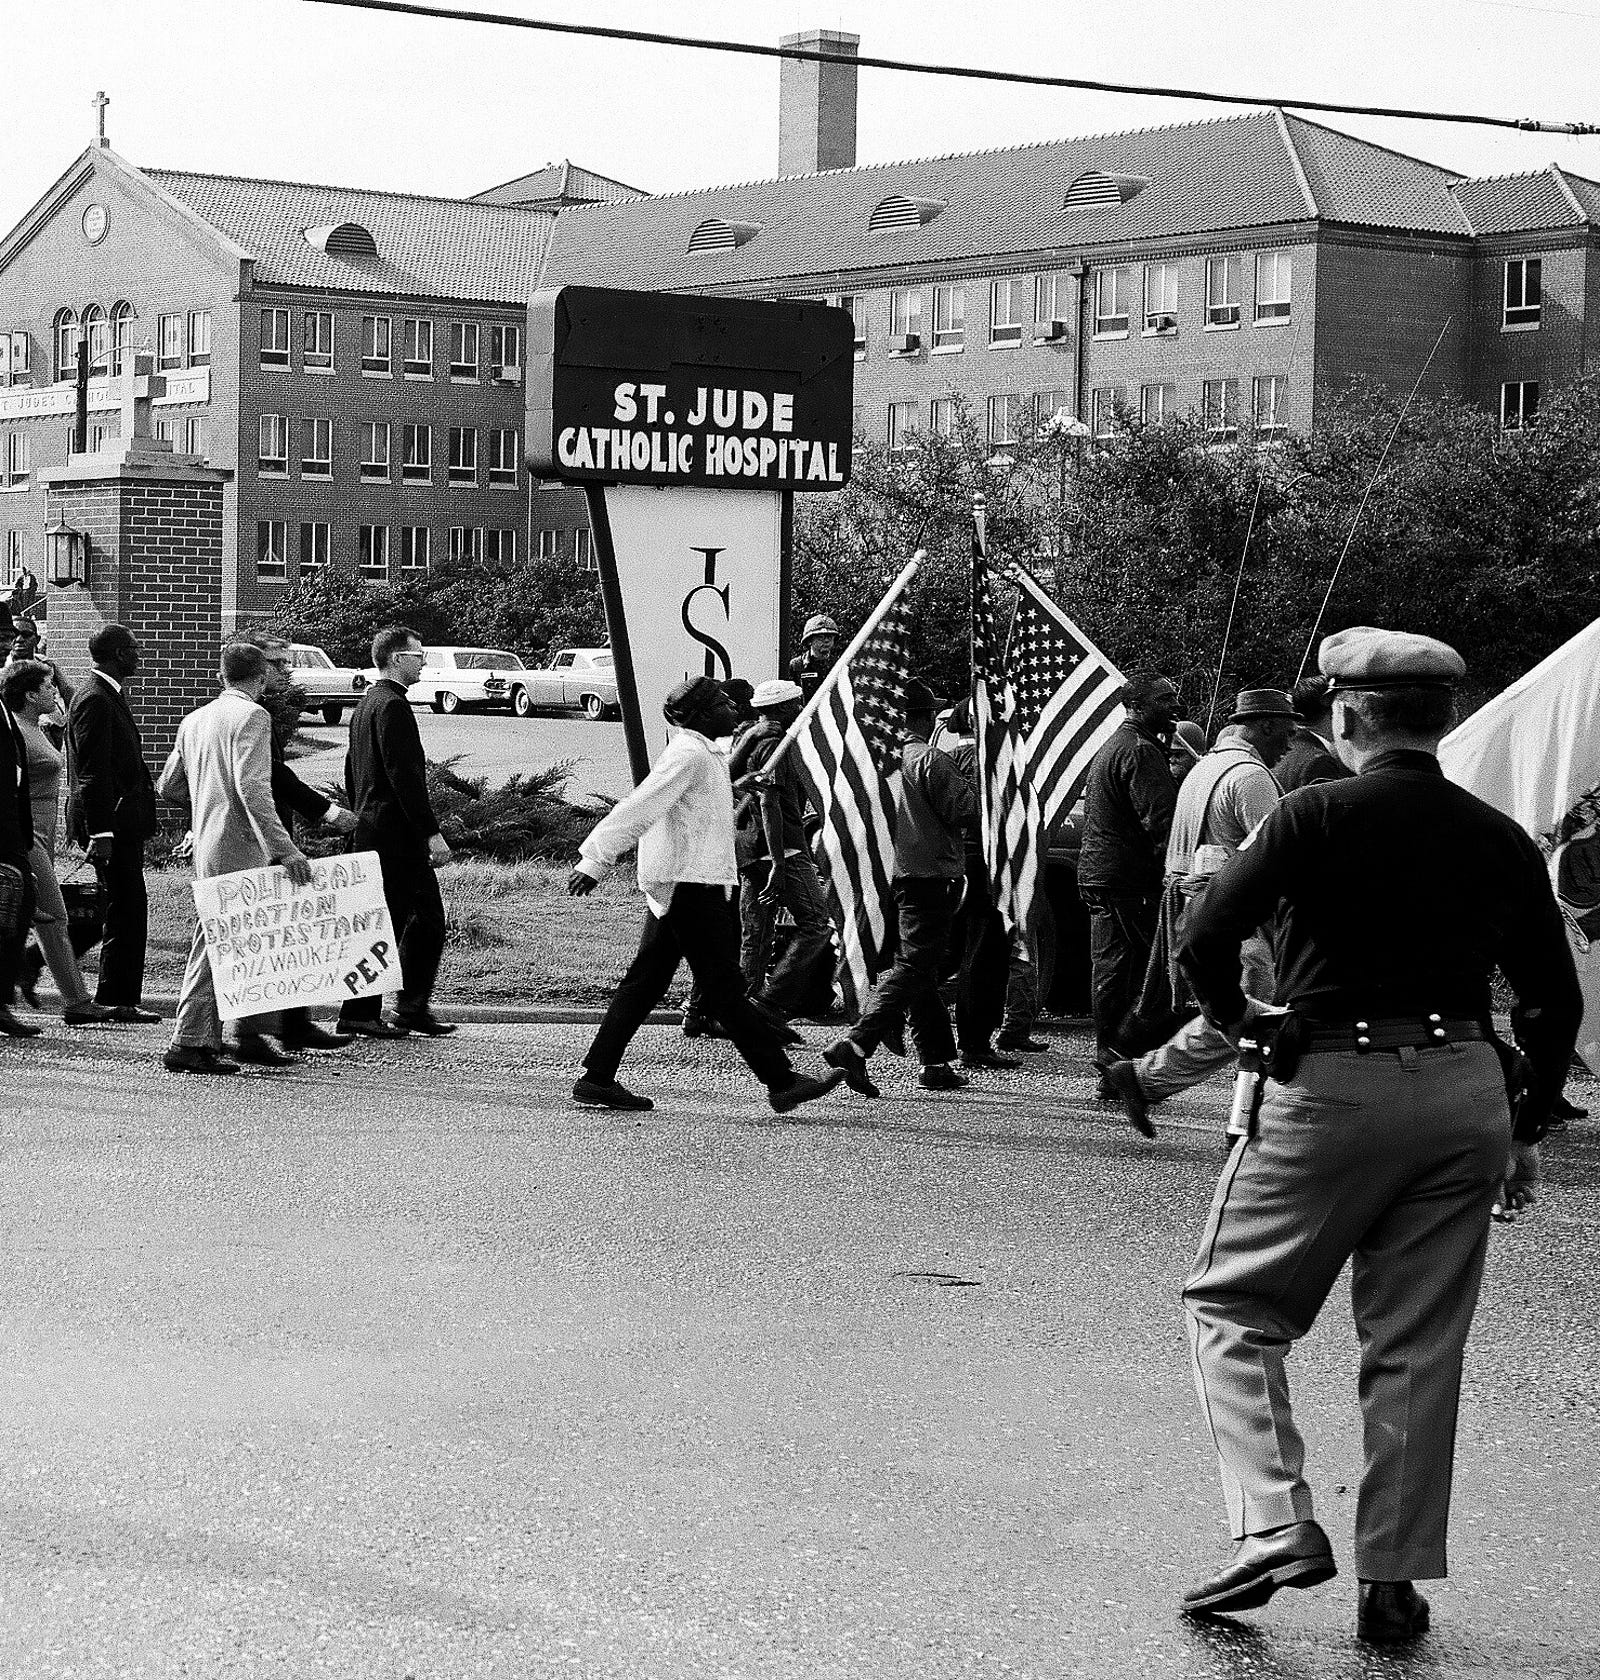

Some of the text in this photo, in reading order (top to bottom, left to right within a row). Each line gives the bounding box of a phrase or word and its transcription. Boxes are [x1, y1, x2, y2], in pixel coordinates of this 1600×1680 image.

[613, 382, 794, 432] ST. JUDE
[558, 426, 843, 481] CATHOLIC HOSPITAL
[217, 860, 366, 914] POLICAL
[205, 895, 336, 946] EDUCATION
[216, 908, 387, 965] PROTESTANT
[232, 941, 350, 982] MILWAUKEE
[223, 968, 339, 1008] WISCONSIN
